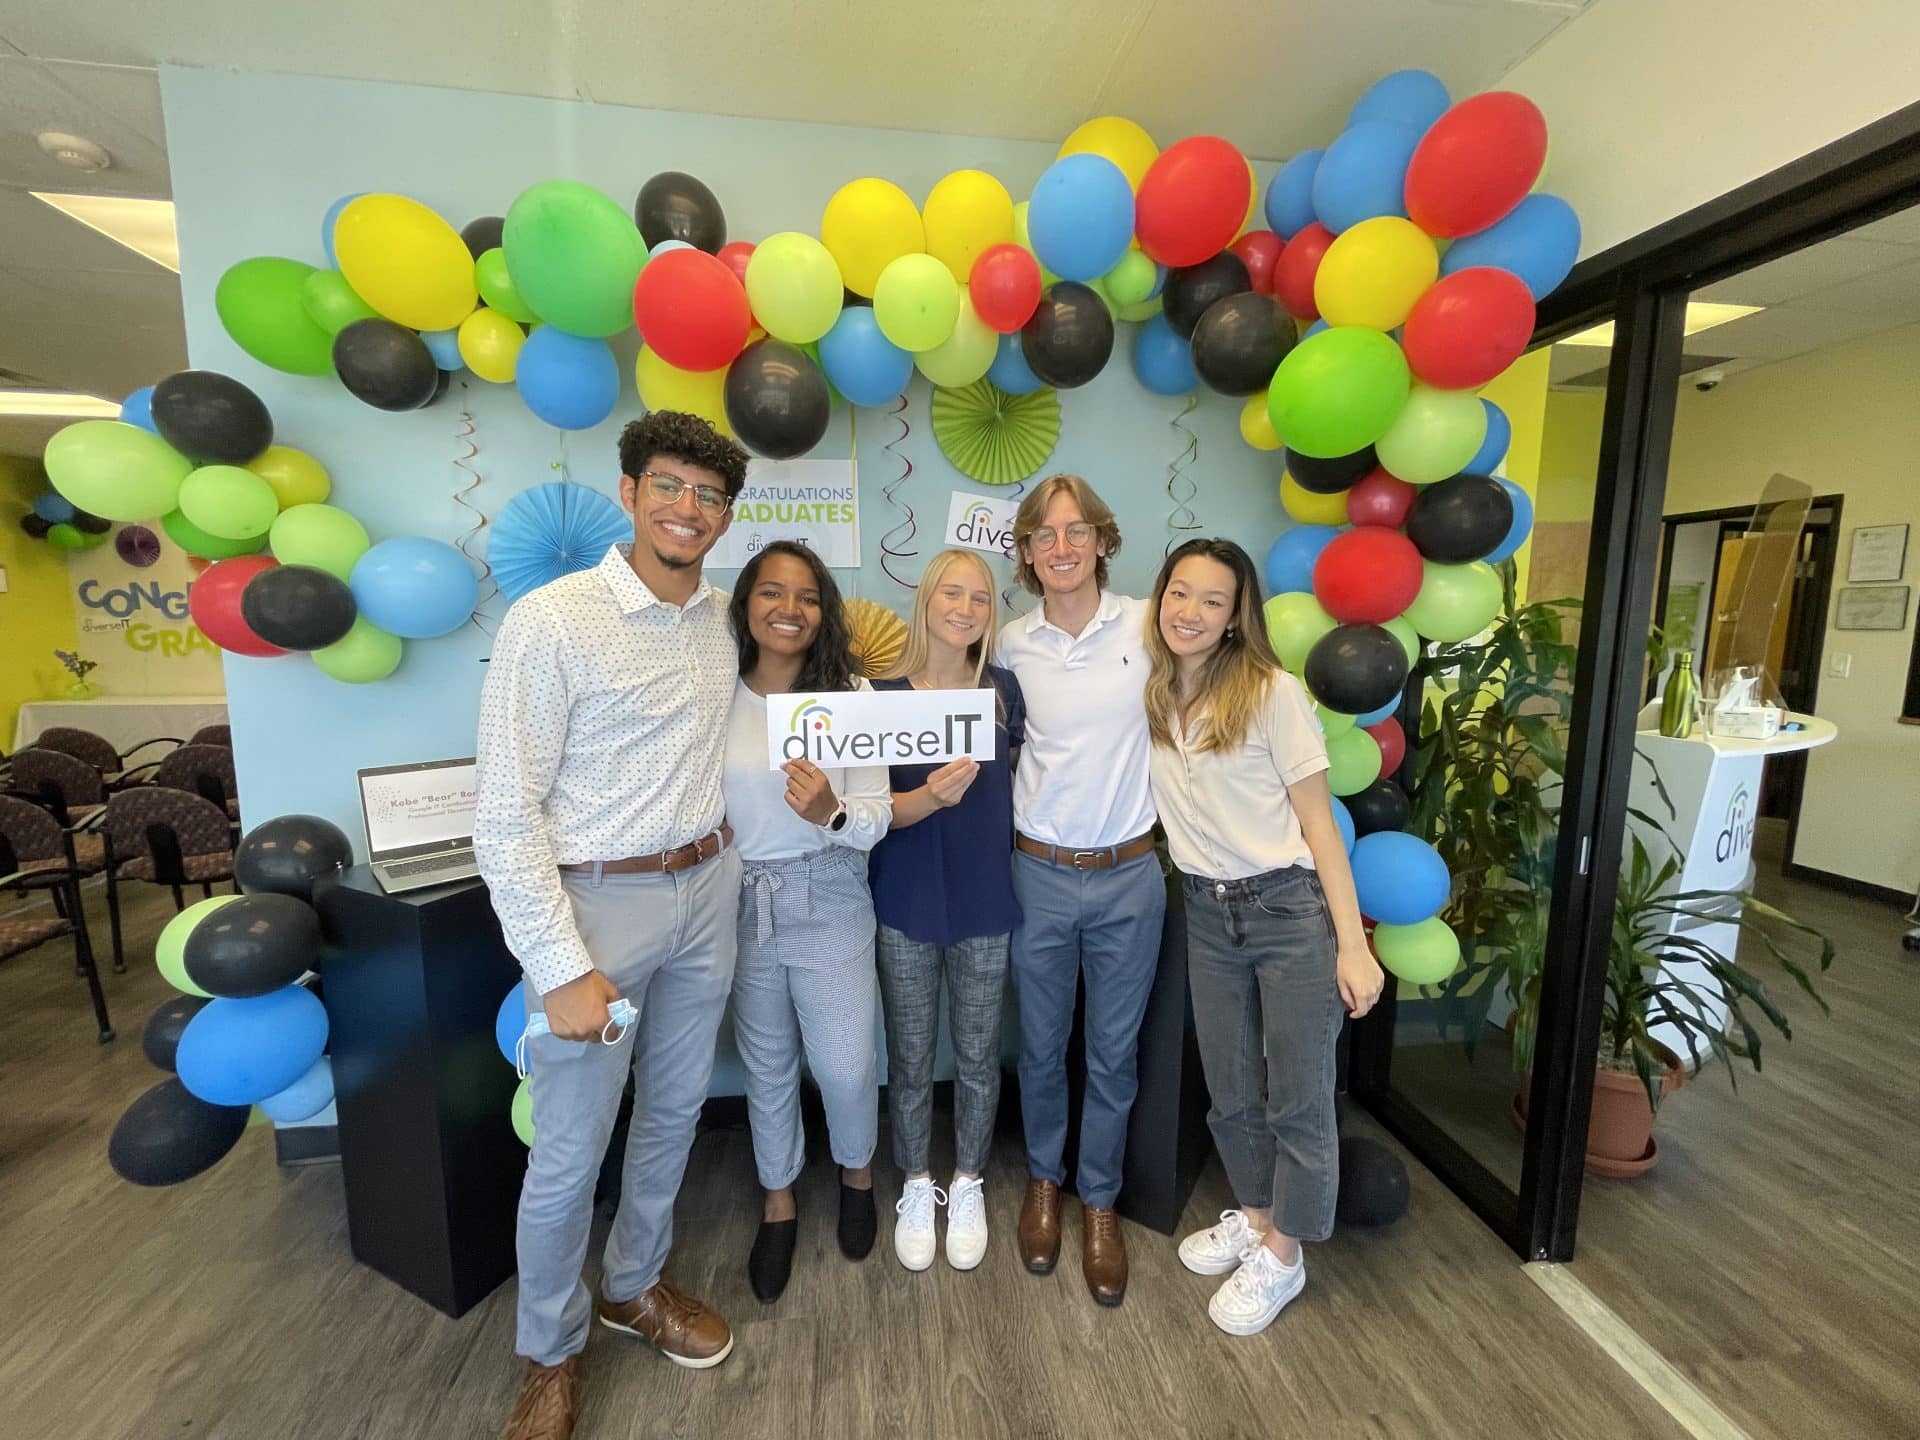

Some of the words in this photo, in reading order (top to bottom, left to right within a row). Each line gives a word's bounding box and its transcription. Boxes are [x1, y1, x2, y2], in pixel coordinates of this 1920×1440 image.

[737, 487, 853, 500] GRATULATIONS
[733, 503, 854, 523] ADUATES
[78, 580, 193, 620] CONG
[783, 713, 982, 761] diverseIT
